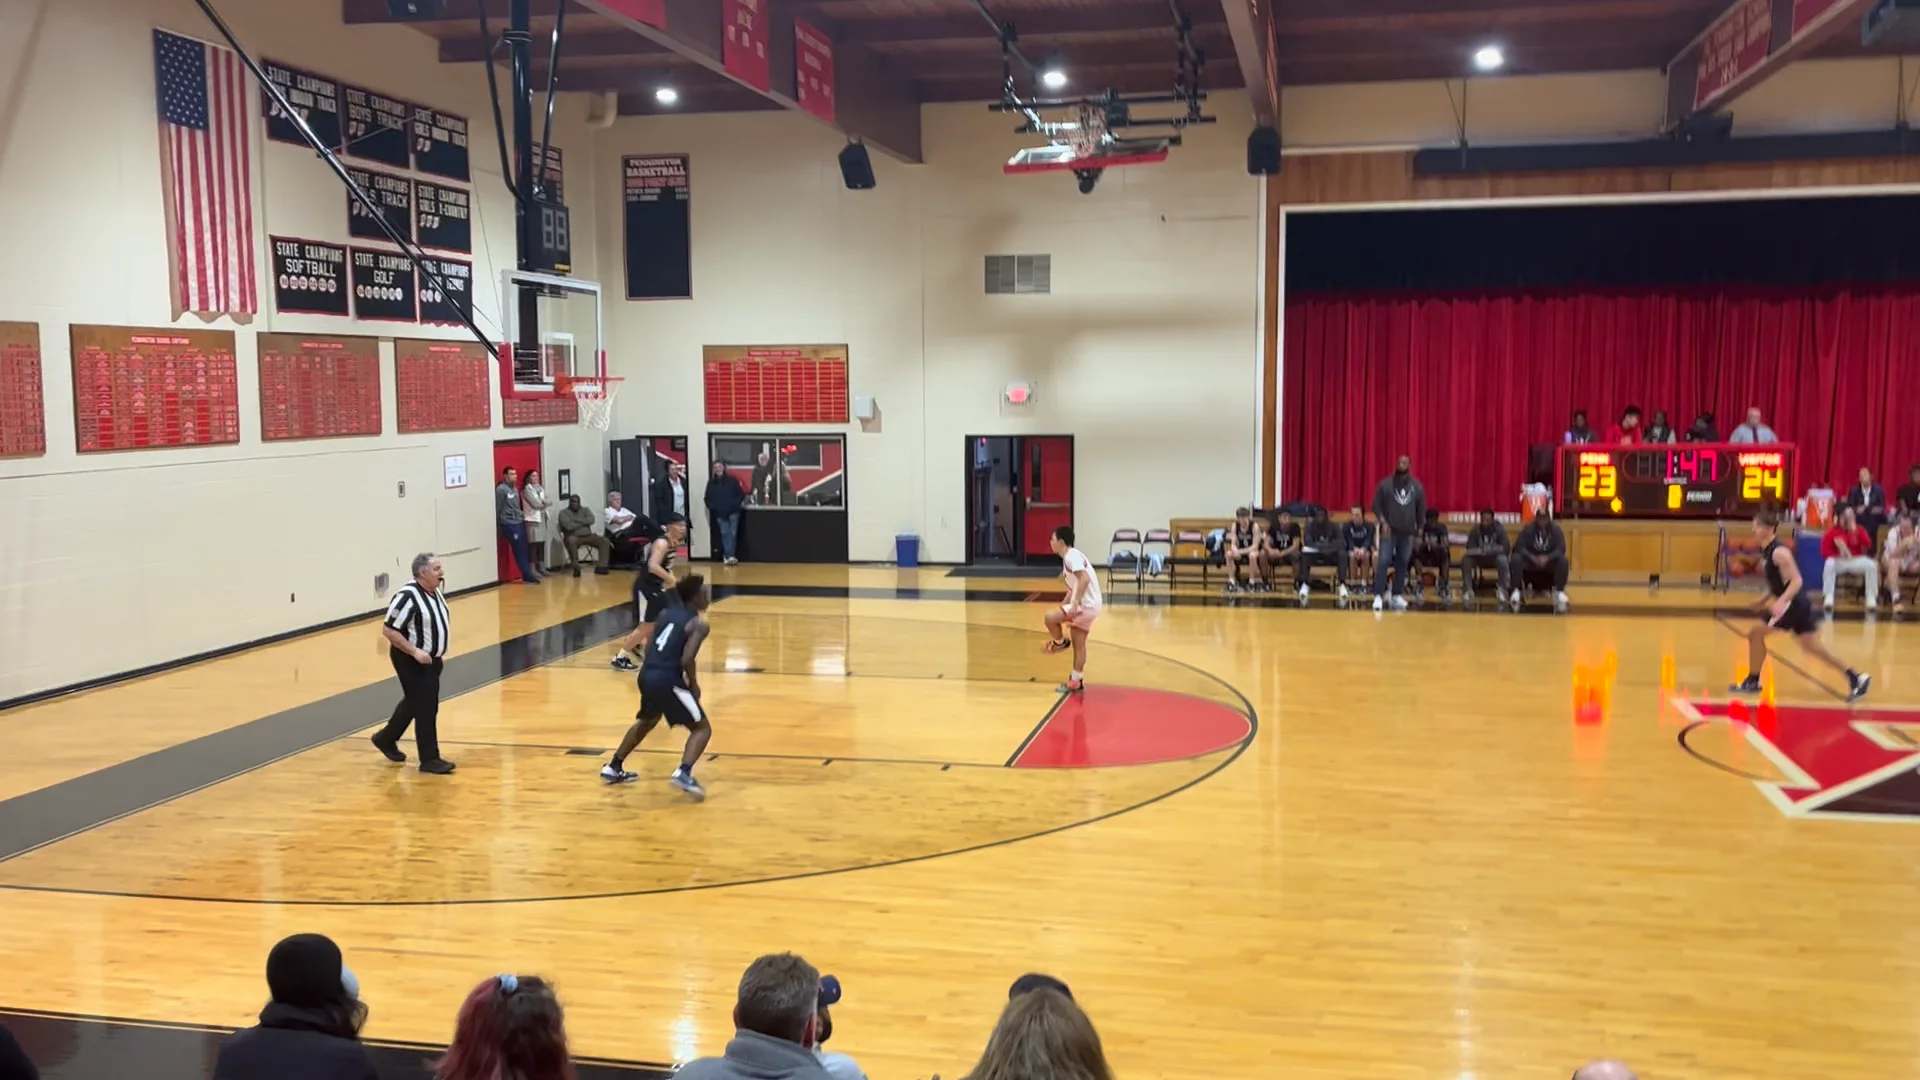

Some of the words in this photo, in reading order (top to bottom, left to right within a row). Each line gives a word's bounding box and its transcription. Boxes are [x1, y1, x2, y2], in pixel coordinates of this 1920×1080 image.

[268, 66, 292, 86] STATE
[297, 75, 336, 98] CHAMPIONS
[346, 88, 366, 107] STATE
[371, 95, 405, 118] CHAMPIONS
[349, 103, 372, 123] BOYS
[376, 110, 404, 132] TRACK
[415, 107, 432, 125] STATE
[626, 166, 686, 177] BASKETBALL
[374, 175, 409, 195] CHAMPIONS
[418, 185, 435, 200] STATE
[381, 191, 408, 208] TRACK
[276, 241, 300, 257] STATE
[305, 245, 343, 263] CHAMPIONS
[285, 258, 337, 277] SOFTBALL
[355, 252, 374, 267] STATE
[379, 256, 412, 272] CHAMPIONS
[441, 262, 469, 278] CHAMPIONS
[373, 270, 395, 285] GOLF
[1580, 452, 1610, 465] PENN
[1667, 450, 1717, 482] 1:47
[1738, 452, 1781, 467] VISITOR
[1579, 465, 1617, 498] 23
[1743, 467, 1783, 499] 24
[1687, 490, 1712, 502] PERIOD
[655, 622, 675, 652] 4
